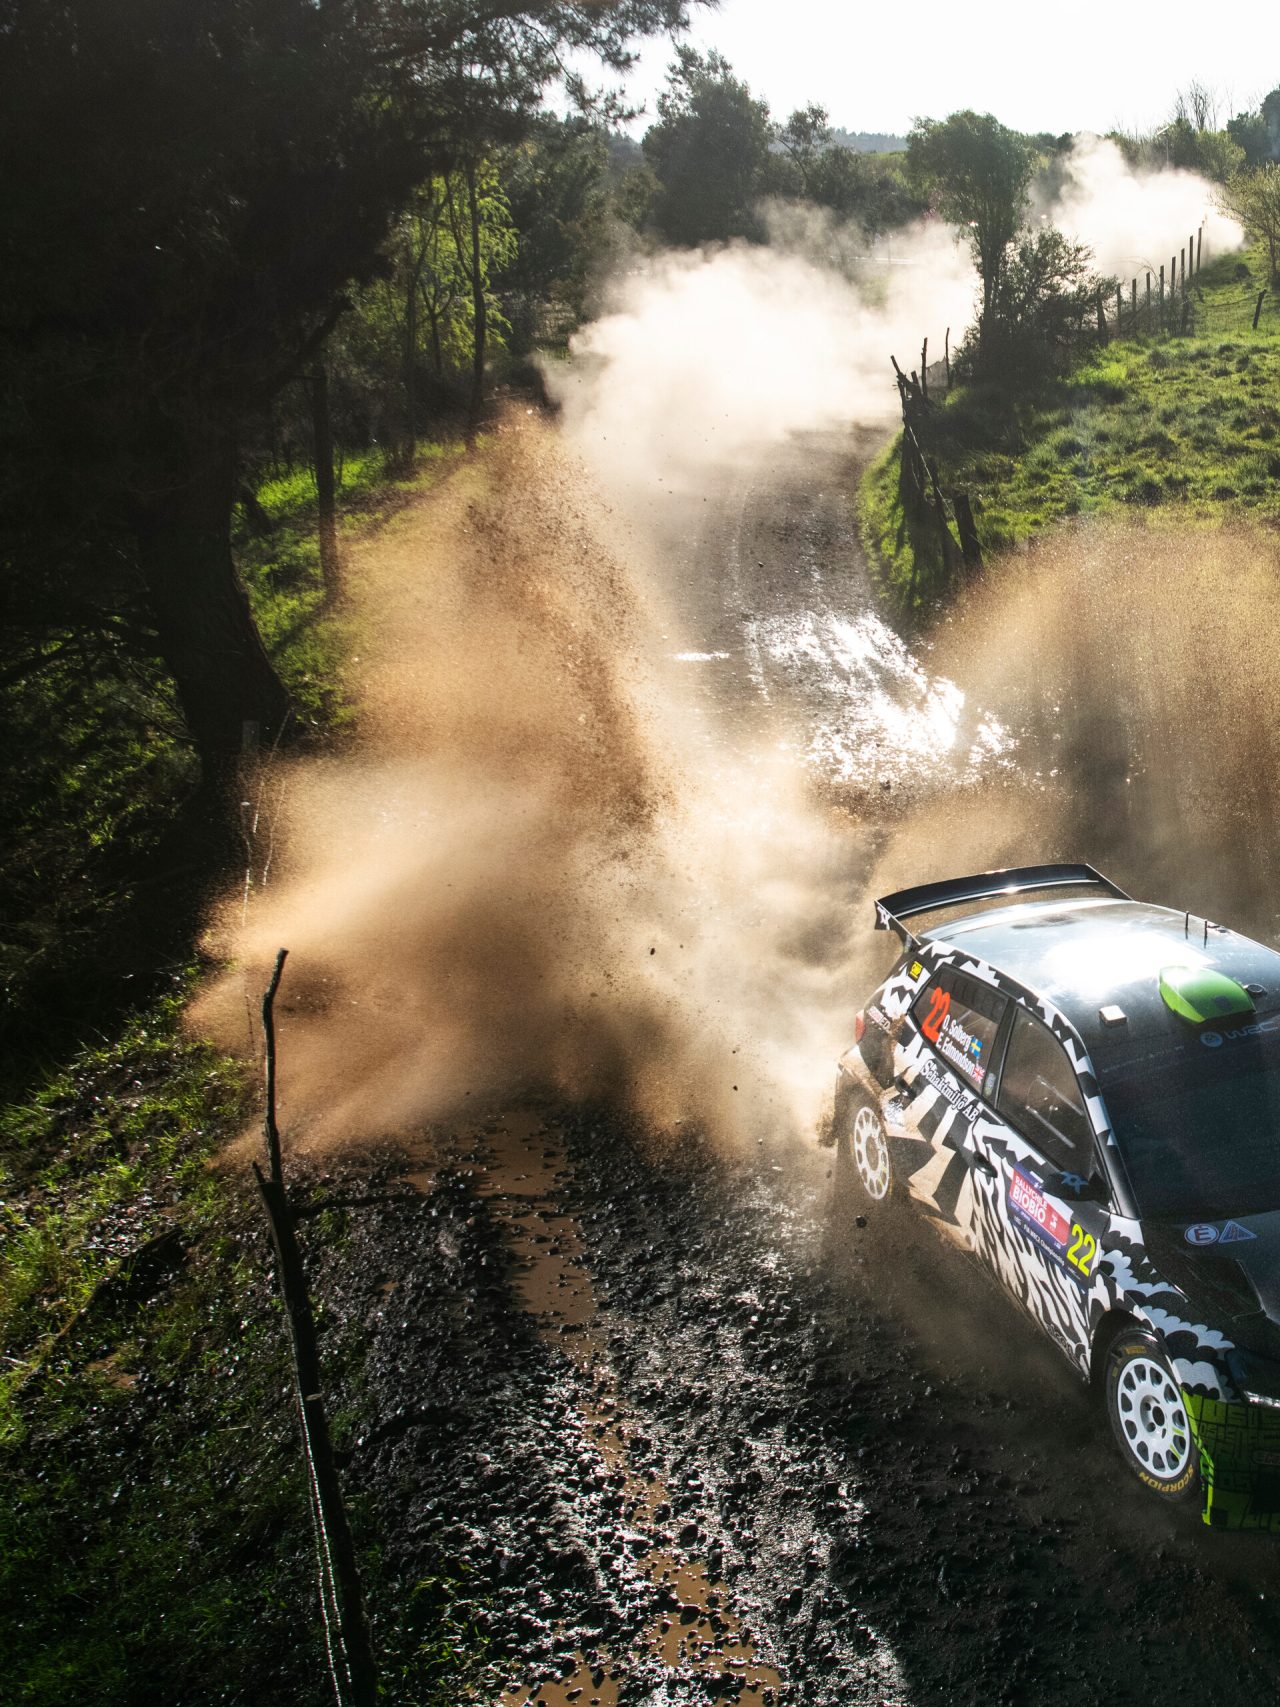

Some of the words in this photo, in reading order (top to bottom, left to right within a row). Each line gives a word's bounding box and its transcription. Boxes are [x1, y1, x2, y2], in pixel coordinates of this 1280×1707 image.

[921, 987, 950, 1042] 22
[936, 1032, 945, 1049] E.
[942, 1014, 951, 1031] O.
[949, 1020, 974, 1052] Solberg
[962, 1104, 979, 1121] AB
[1067, 1223, 1096, 1277] 22
[1138, 1463, 1194, 1492] SCORPION
